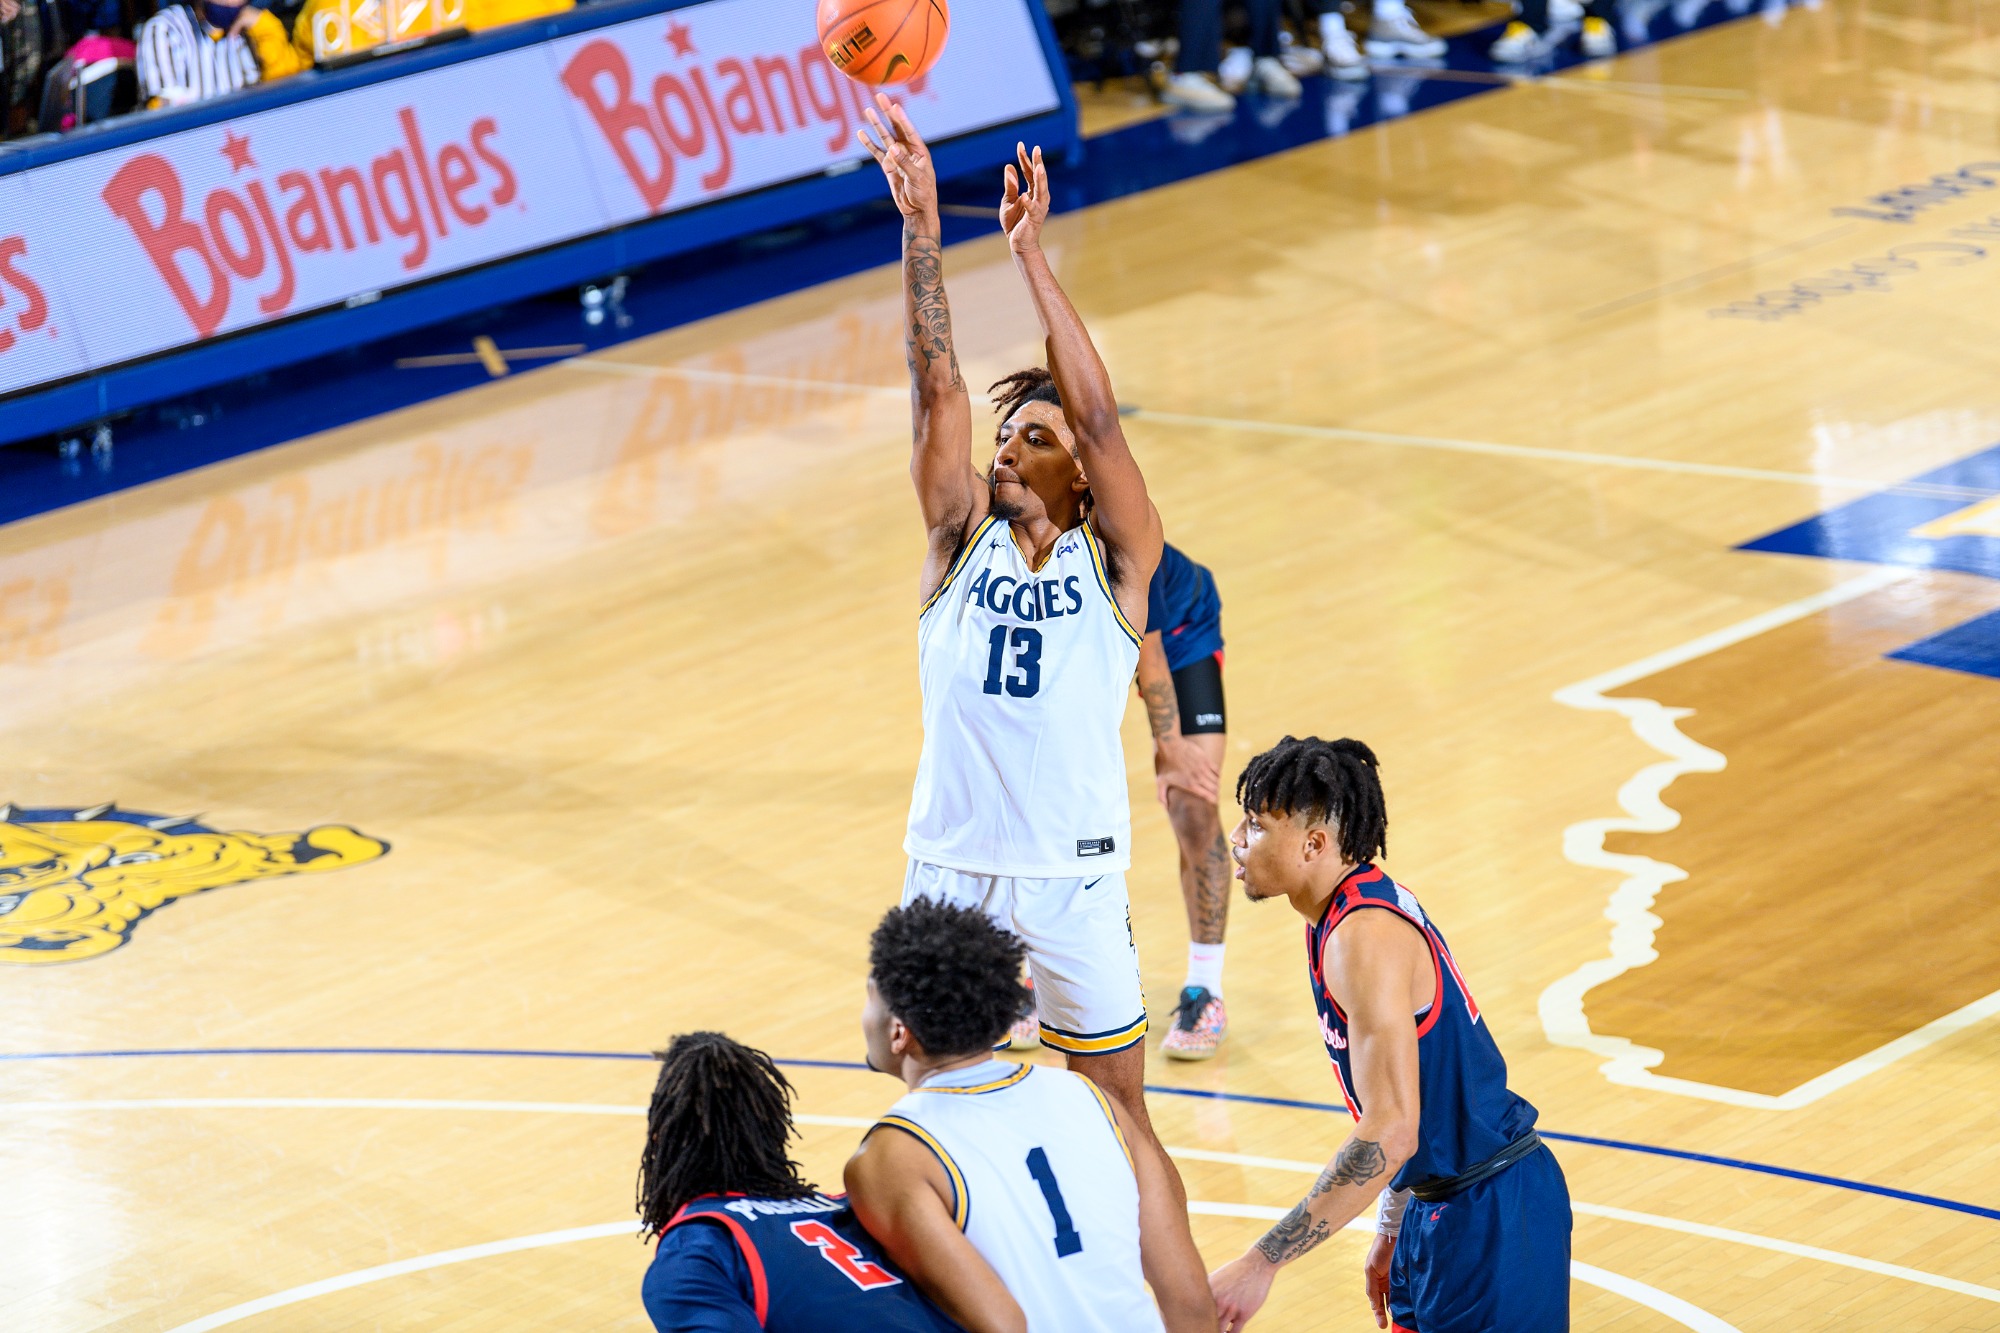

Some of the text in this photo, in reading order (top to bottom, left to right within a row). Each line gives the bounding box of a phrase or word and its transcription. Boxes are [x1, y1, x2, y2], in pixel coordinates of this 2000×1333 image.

[561, 21, 928, 213] Bojang
[102, 107, 516, 338] Bojangles
[966, 566, 1083, 622] AGGIES
[982, 624, 1043, 699] 13
[1025, 1146, 1083, 1259] 1
[789, 1218, 904, 1292] 2
